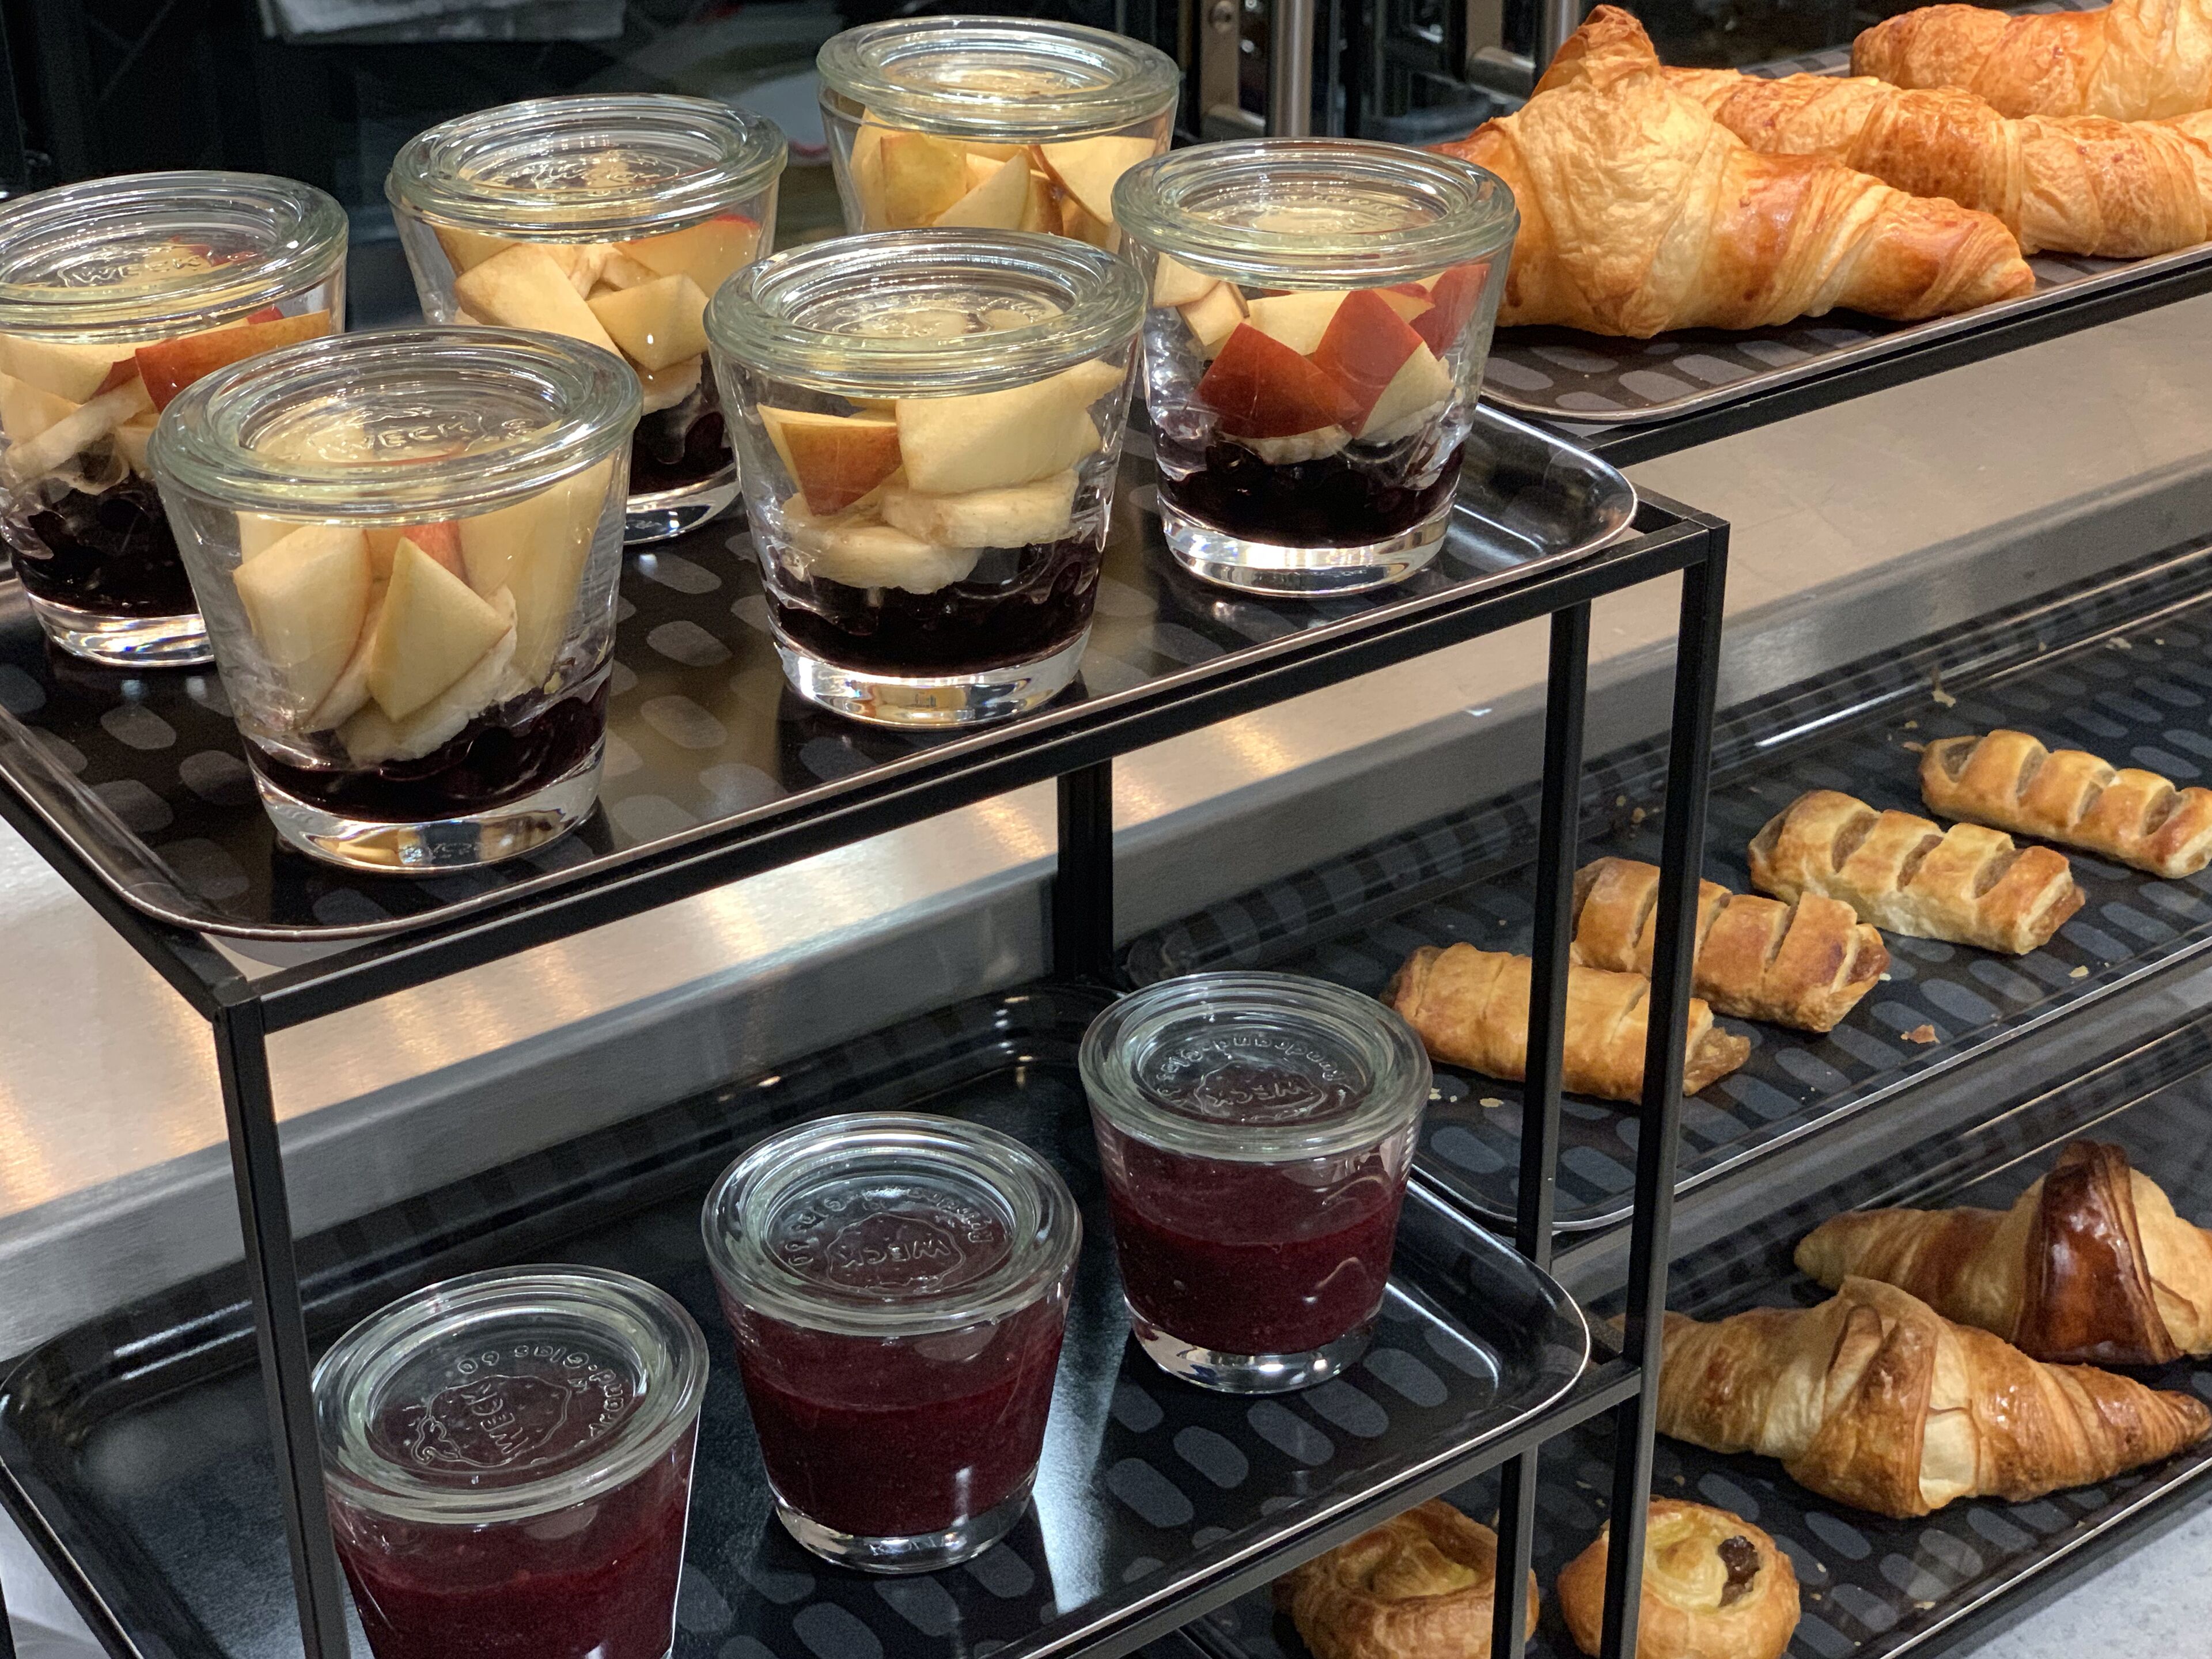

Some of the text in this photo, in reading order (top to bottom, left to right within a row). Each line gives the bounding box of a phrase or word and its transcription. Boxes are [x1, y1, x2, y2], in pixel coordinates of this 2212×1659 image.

[71, 255, 202, 284] WECK
[1205, 1081, 1312, 1107] WECK
[836, 1238, 952, 1268] WECK
[461, 1382, 529, 1455] WECK
